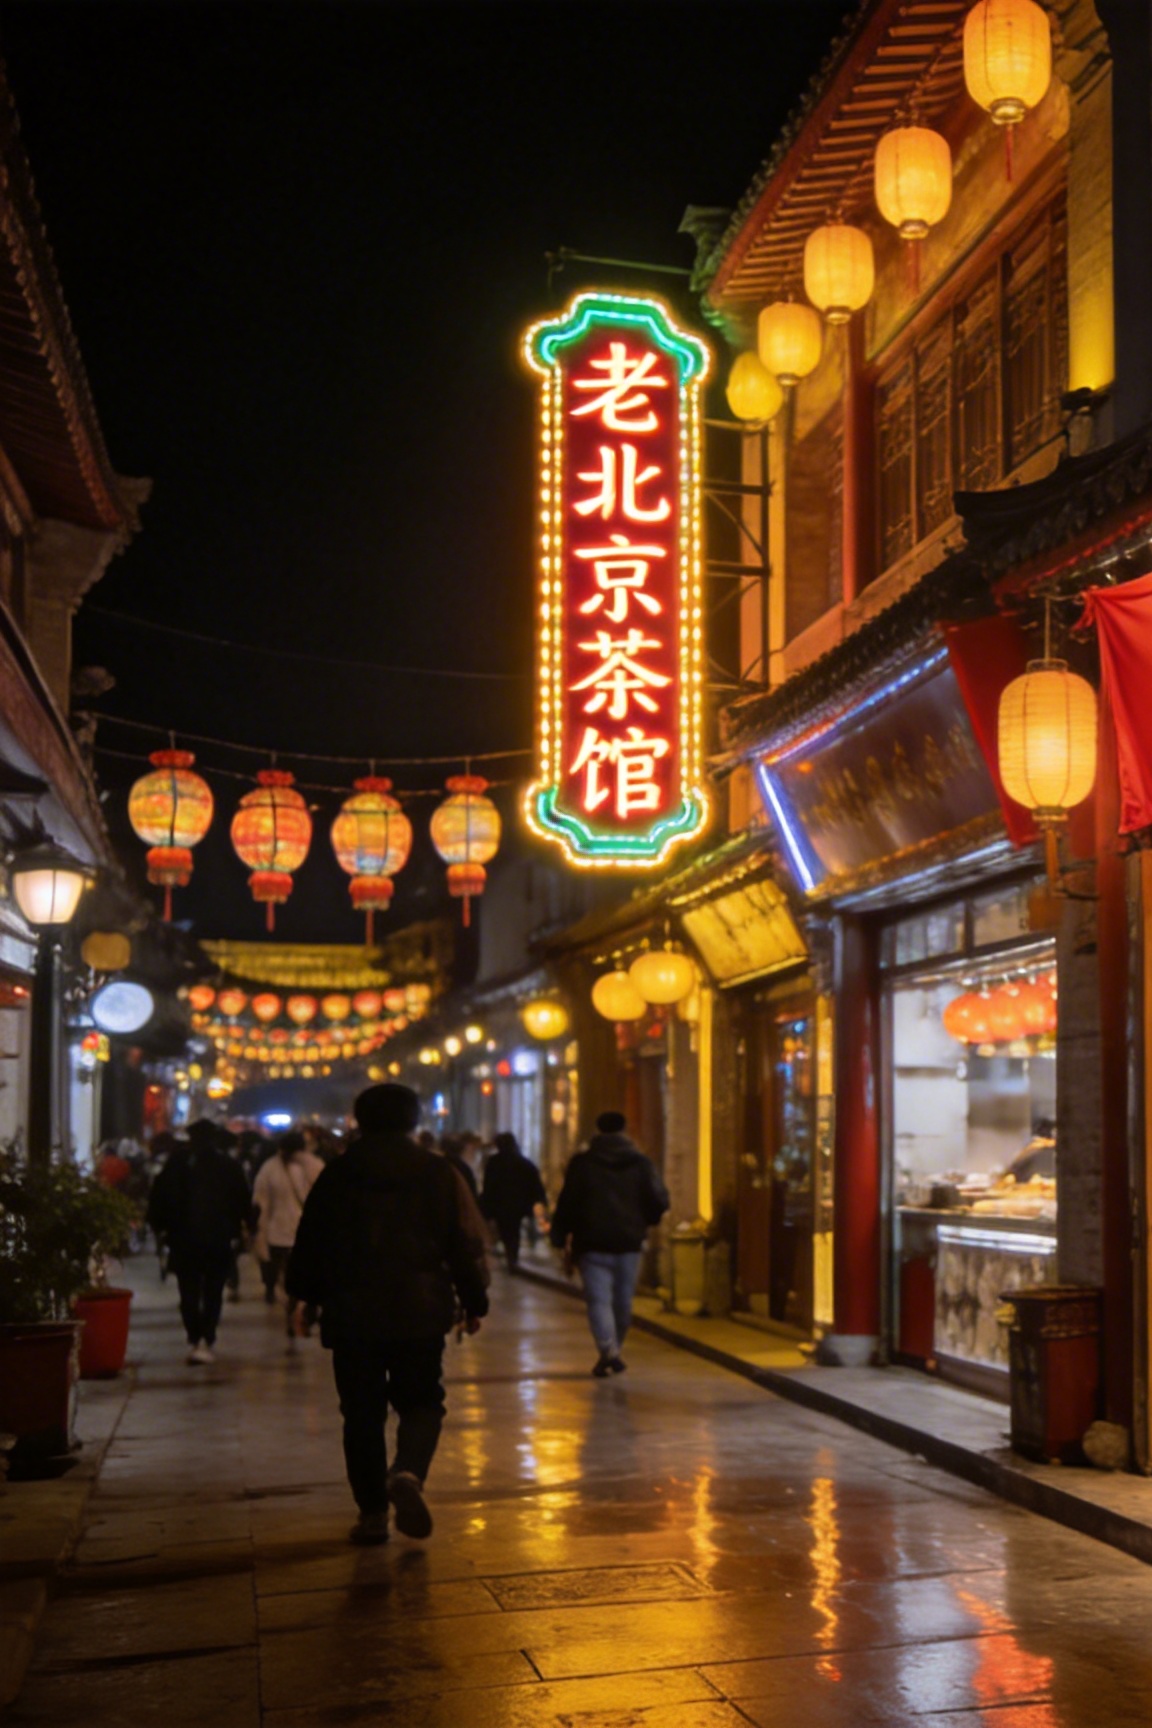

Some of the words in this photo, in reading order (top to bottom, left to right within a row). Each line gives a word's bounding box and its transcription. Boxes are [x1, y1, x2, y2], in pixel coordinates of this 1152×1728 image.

[570, 341, 672, 819] 老北京茶馆
